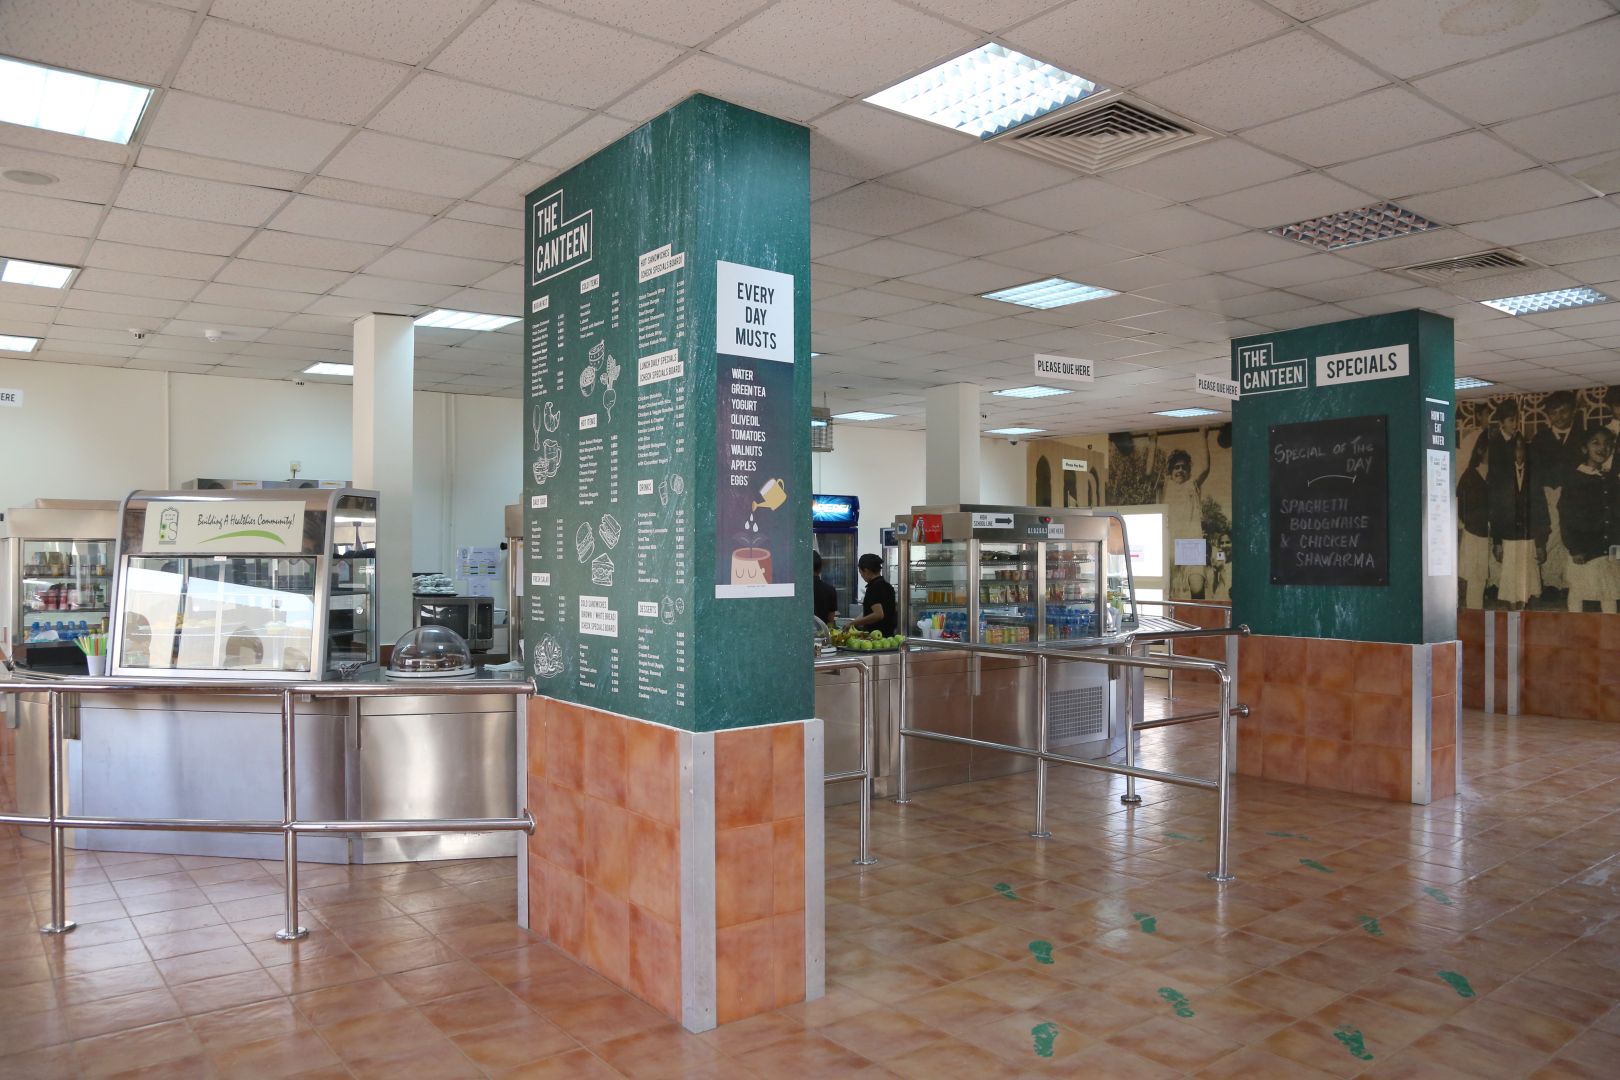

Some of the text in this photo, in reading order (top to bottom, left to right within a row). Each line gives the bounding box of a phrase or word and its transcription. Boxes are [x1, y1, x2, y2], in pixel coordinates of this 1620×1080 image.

[538, 202, 558, 237] THE
[537, 223, 588, 273] CANTEEN
[738, 282, 774, 304] EVERY
[746, 306, 766, 325] DAY
[736, 327, 776, 349] MUSTS
[1243, 349, 1267, 368] THE
[1327, 352, 1397, 379] SPECIALS
[731, 368, 753, 381] WATER
[1038, 360, 1090, 376] PLEASE QUE HERE
[1244, 366, 1303, 389] CANTEEN
[731, 384, 766, 397] GREEN TEA
[1199, 379, 1237, 395] PLEASE QUE HERE
[0, 392, 15, 402] ERE
[731, 399, 757, 411] YOGURT
[731, 414, 760, 426] OLIVE OIL
[731, 429, 766, 442] TOMATOES
[731, 444, 762, 456] WALNUTS
[731, 460, 756, 471] APPLES
[1346, 456, 1372, 473] DAY
[730, 475, 748, 486] EGGS
[1280, 498, 1349, 514] SPAGHETTI
[198, 514, 295, 529] Building A Healthier Community!
[1299, 534, 1360, 549] CHICKEN
[1296, 551, 1375, 568] SHAWARMA
